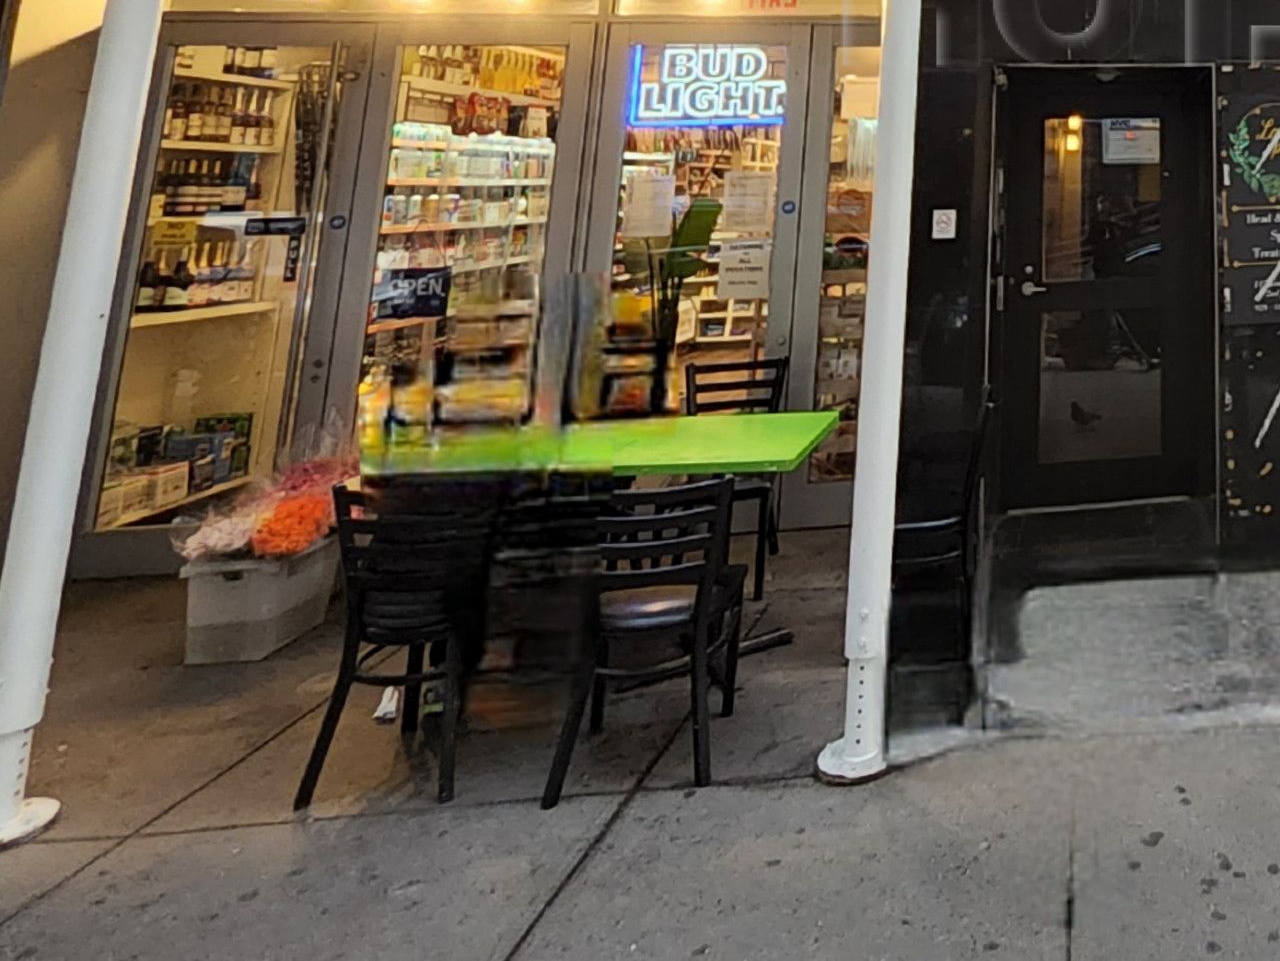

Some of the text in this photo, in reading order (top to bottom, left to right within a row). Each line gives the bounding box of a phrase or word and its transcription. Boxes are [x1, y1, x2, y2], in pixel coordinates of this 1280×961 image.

[662, 47, 767, 82] BUD
[1246, 213, 1272, 224] Head
[285, 240, 299, 278] PULL
[391, 277, 444, 297] OPEN
